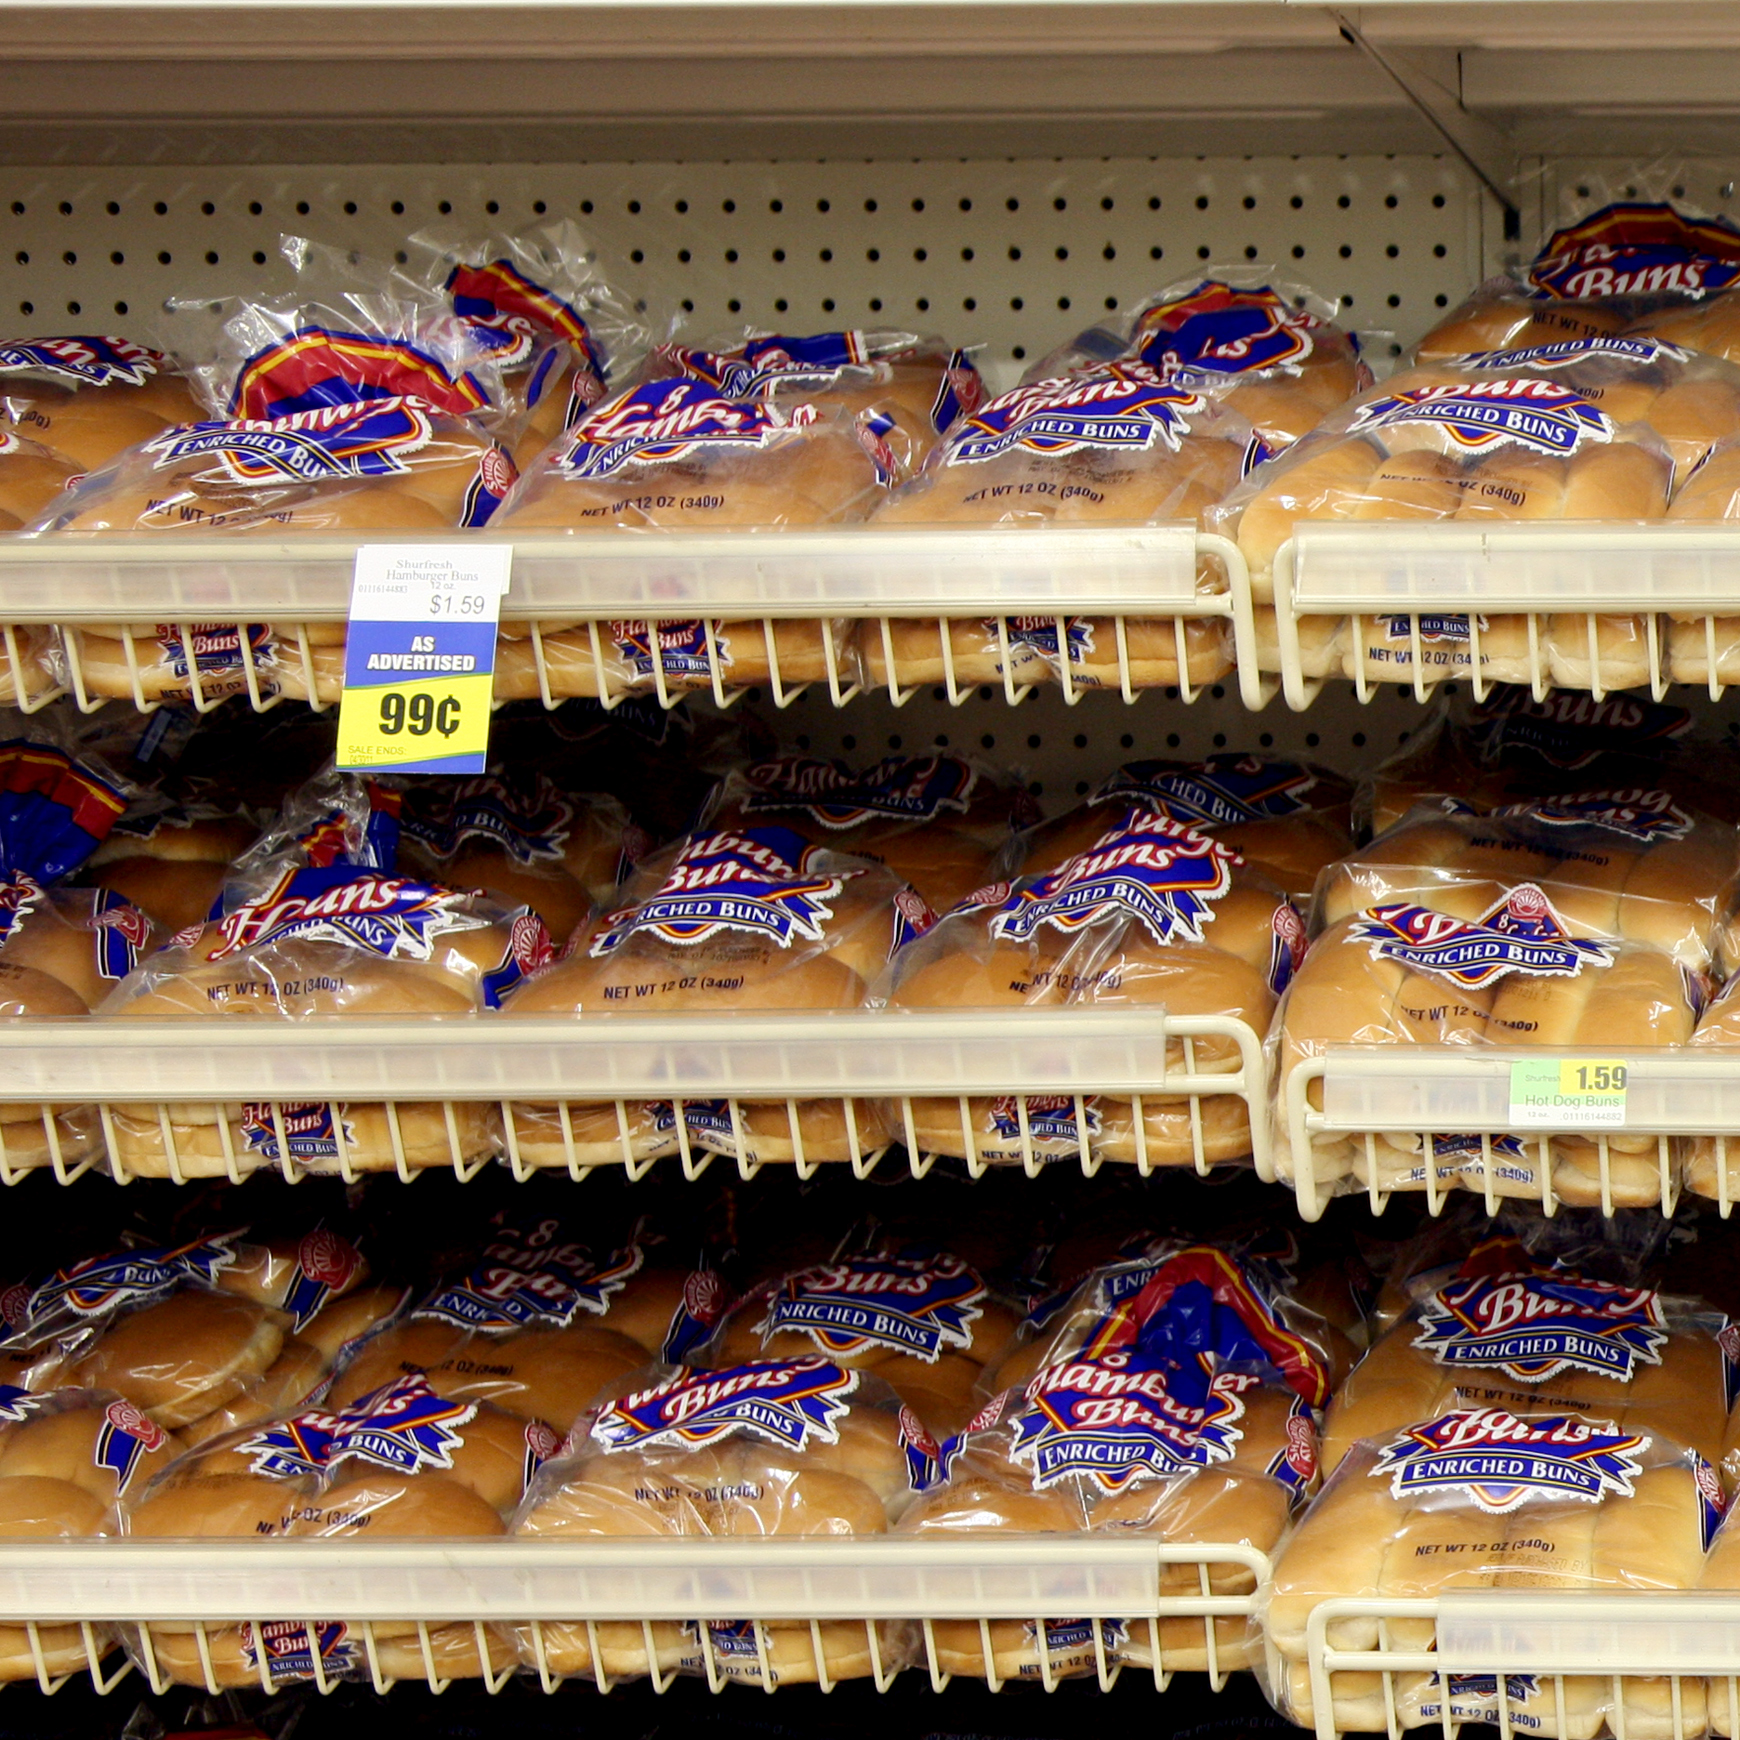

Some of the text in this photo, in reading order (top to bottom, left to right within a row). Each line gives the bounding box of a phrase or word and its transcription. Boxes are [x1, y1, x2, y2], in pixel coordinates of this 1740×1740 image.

[396, 560, 452, 570] Shurfresh
[387, 570, 478, 582] Hamburger Buns
[430, 581, 440, 590] 12
[430, 595, 485, 616] $1.59
[411, 636, 436, 653] AS
[367, 654, 476, 672] ADVERTISED
[380, 693, 461, 739] 99¢
[348, 746, 407, 756] SALE ENDS:
[1576, 1066, 1627, 1090] 1.59
[1526, 1096, 1619, 1109] Hot Dog Buns
[1412, 1458, 1590, 1487] ENRICHED BUNS
